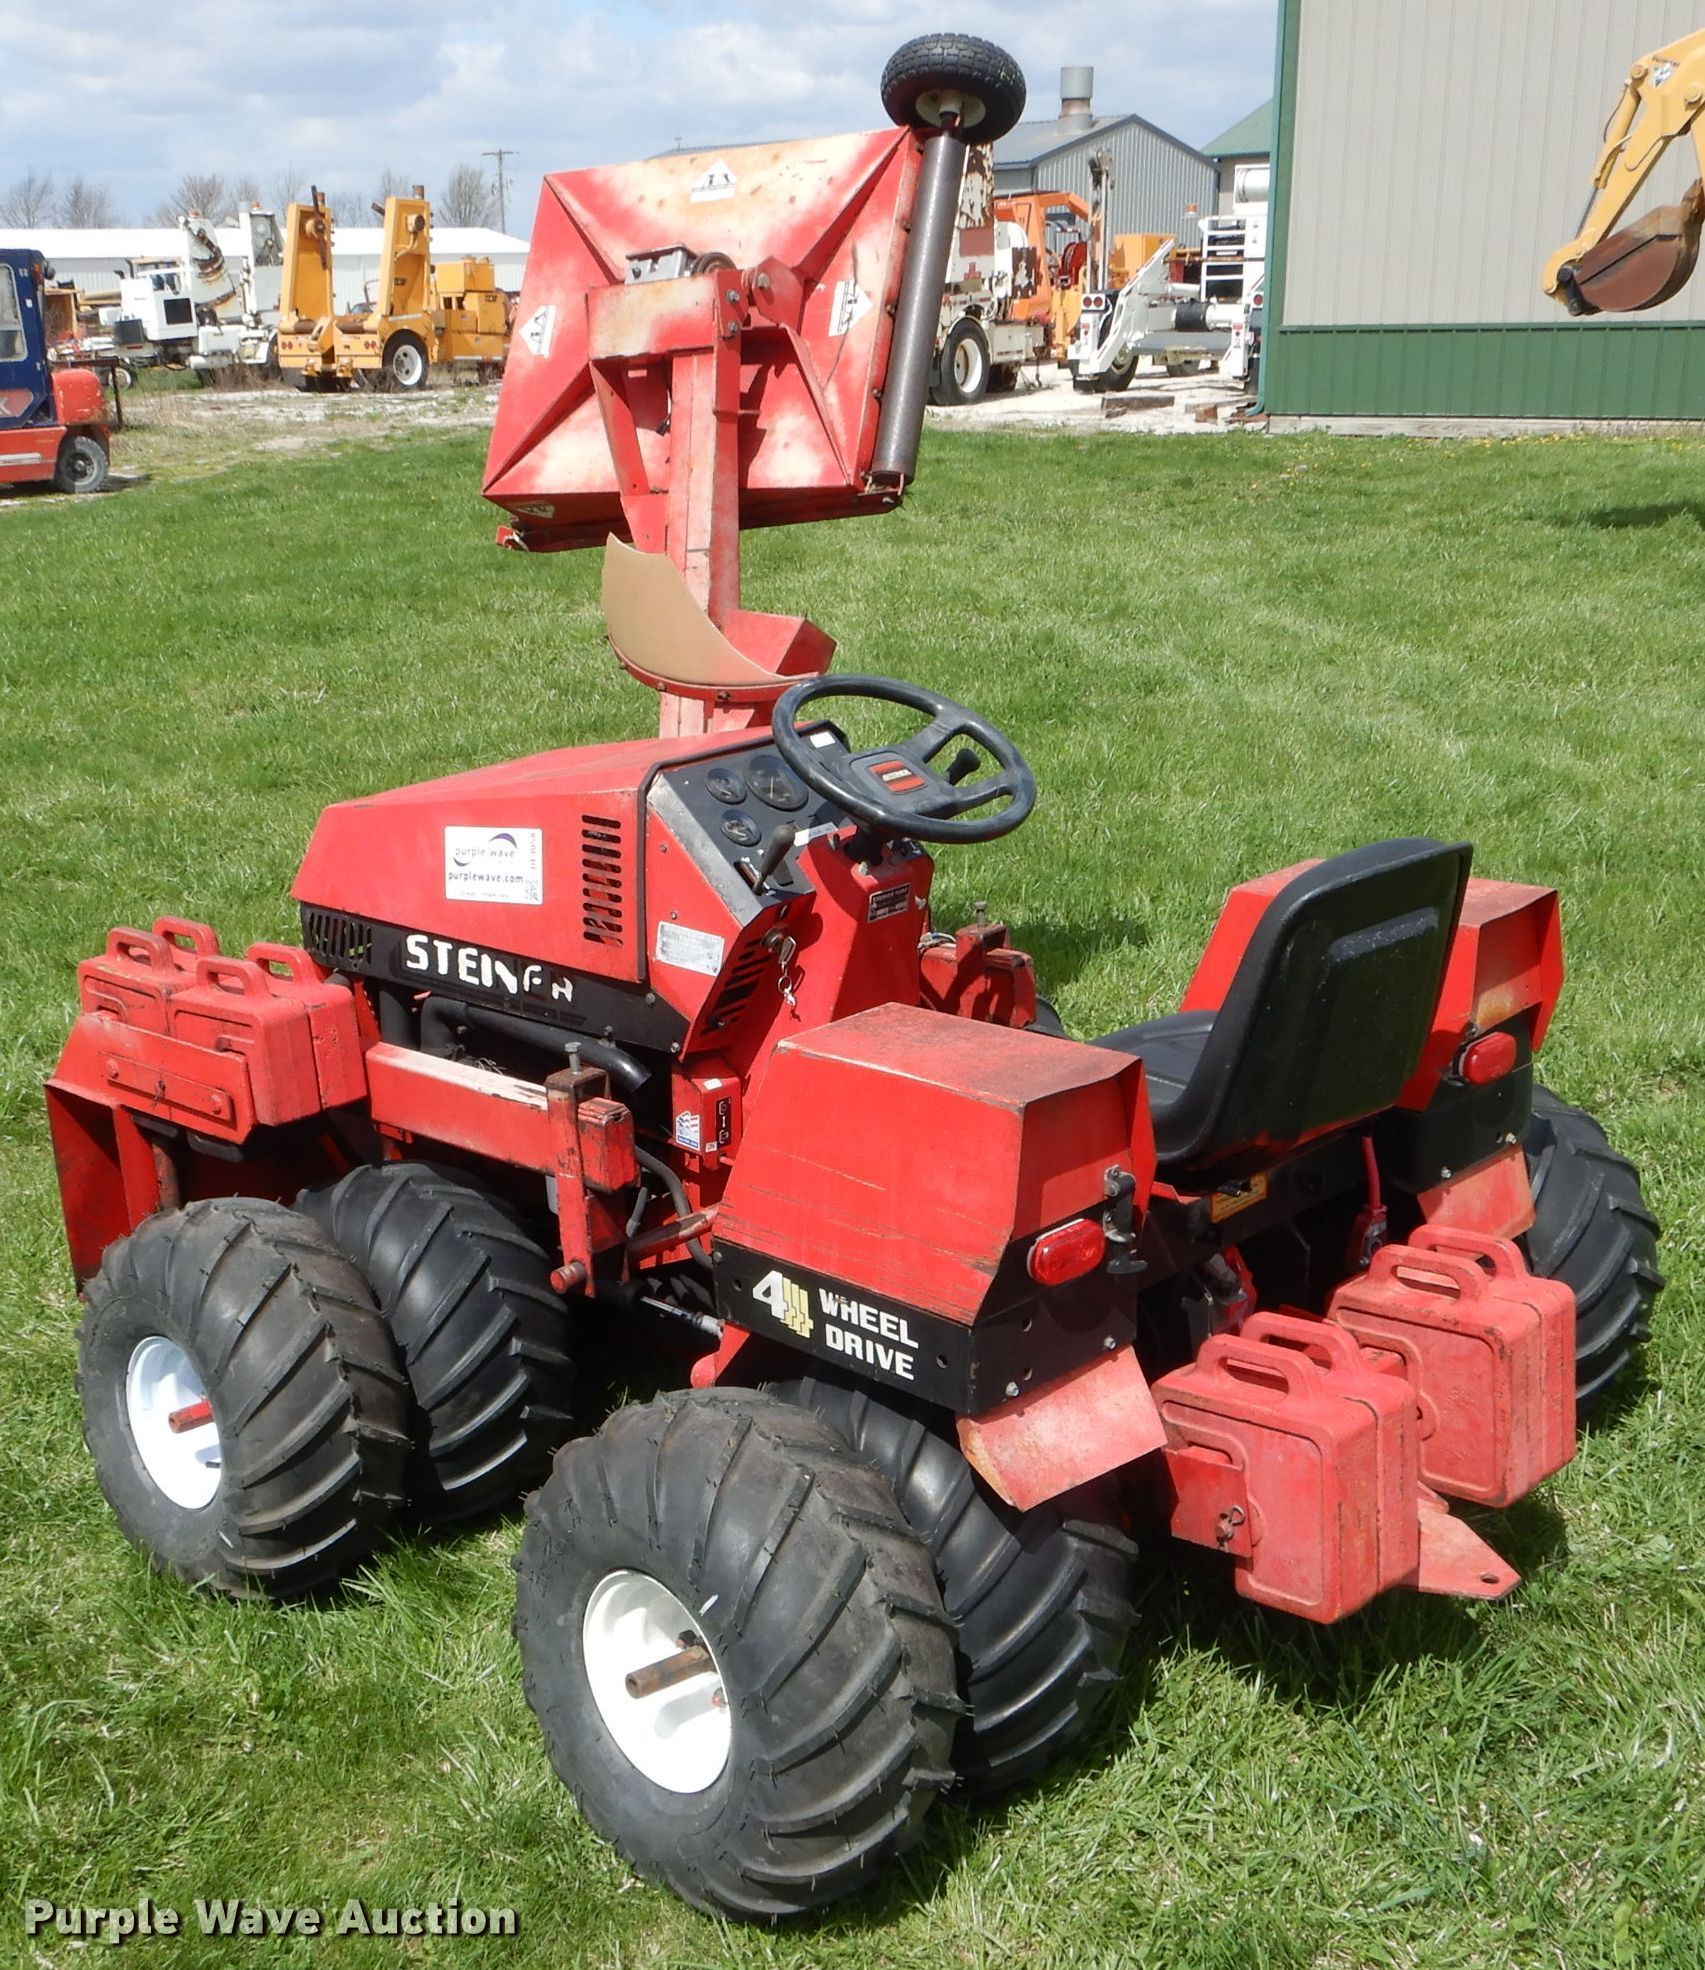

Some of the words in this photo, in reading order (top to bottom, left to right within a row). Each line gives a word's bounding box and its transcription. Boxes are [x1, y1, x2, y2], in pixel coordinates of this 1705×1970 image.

[455, 847, 486, 858] purple
[490, 849, 515, 858] wave
[448, 871, 523, 883] purplewave.com
[818, 1287, 919, 1349] WHEEL
[825, 1323, 915, 1381] DRIVE
